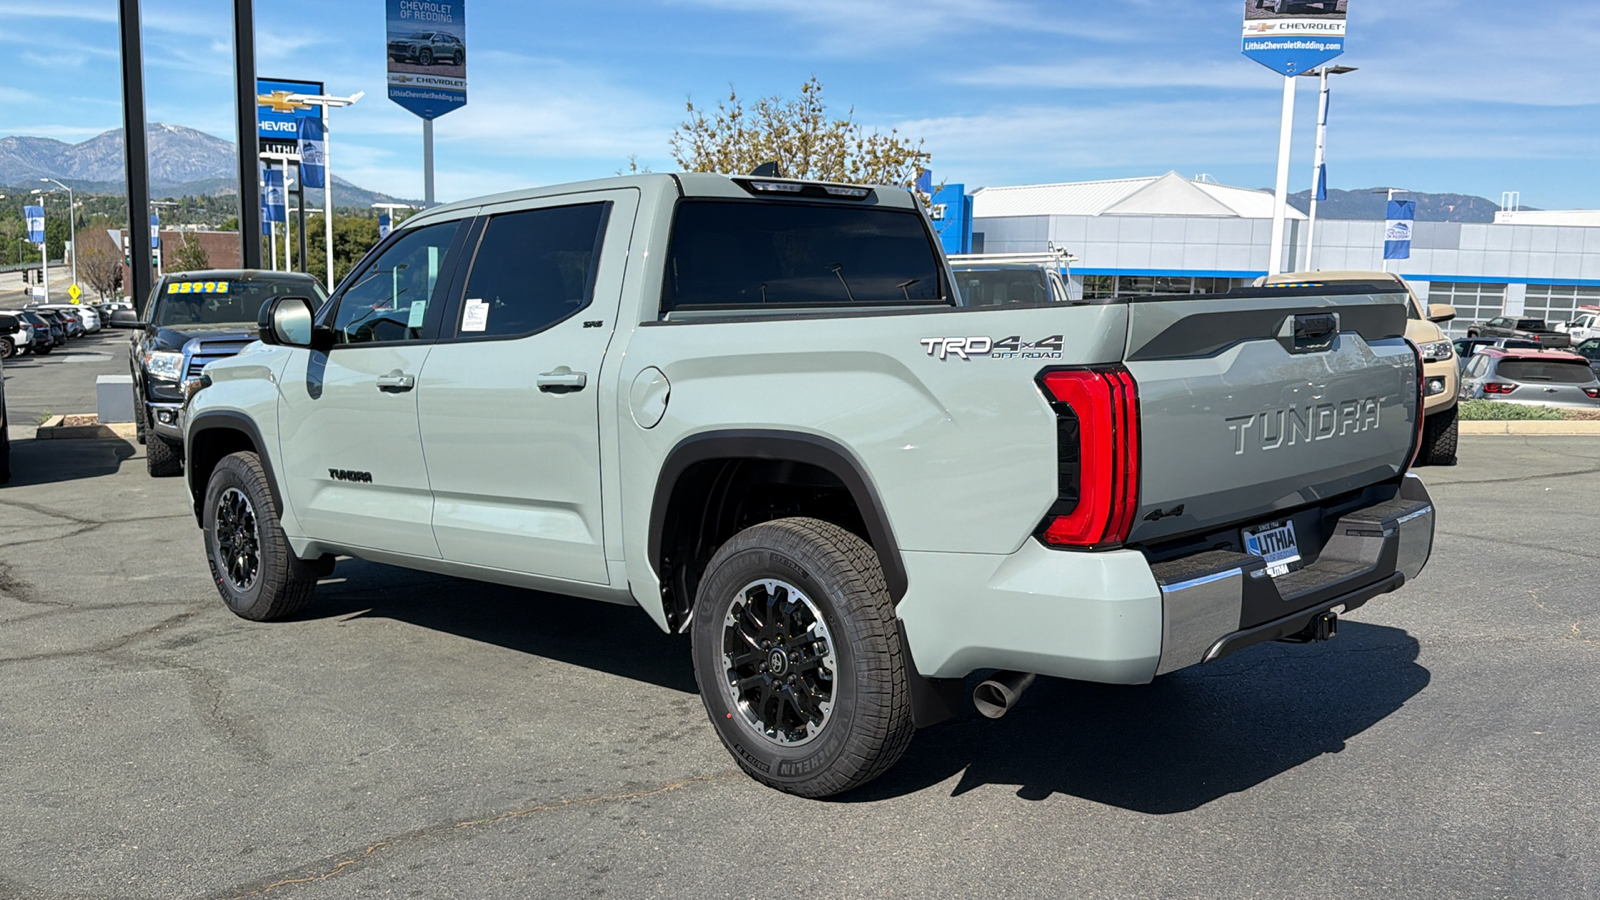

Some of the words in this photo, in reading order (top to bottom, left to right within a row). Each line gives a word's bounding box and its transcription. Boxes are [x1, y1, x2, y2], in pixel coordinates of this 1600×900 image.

[400, 1, 452, 14] CHEVROLET
[400, 10, 412, 19] OF
[414, 11, 452, 23] REDDING
[1279, 22, 1341, 30] CHEVROLET
[1244, 41, 1341, 52] LithiaChevroletRedding.com
[416, 76, 464, 87] CHEVROLET
[390, 90, 465, 102] LithiaChevroletRedding.com
[258, 120, 297, 132] HEVRO
[168, 281, 228, 293] 33995
[920, 336, 993, 361] TRD
[1021, 352, 1063, 360] ROAD
[1225, 396, 1382, 455] TUNDRA
[328, 468, 373, 483] TUNDRA
[1257, 528, 1296, 555] LITHIA
